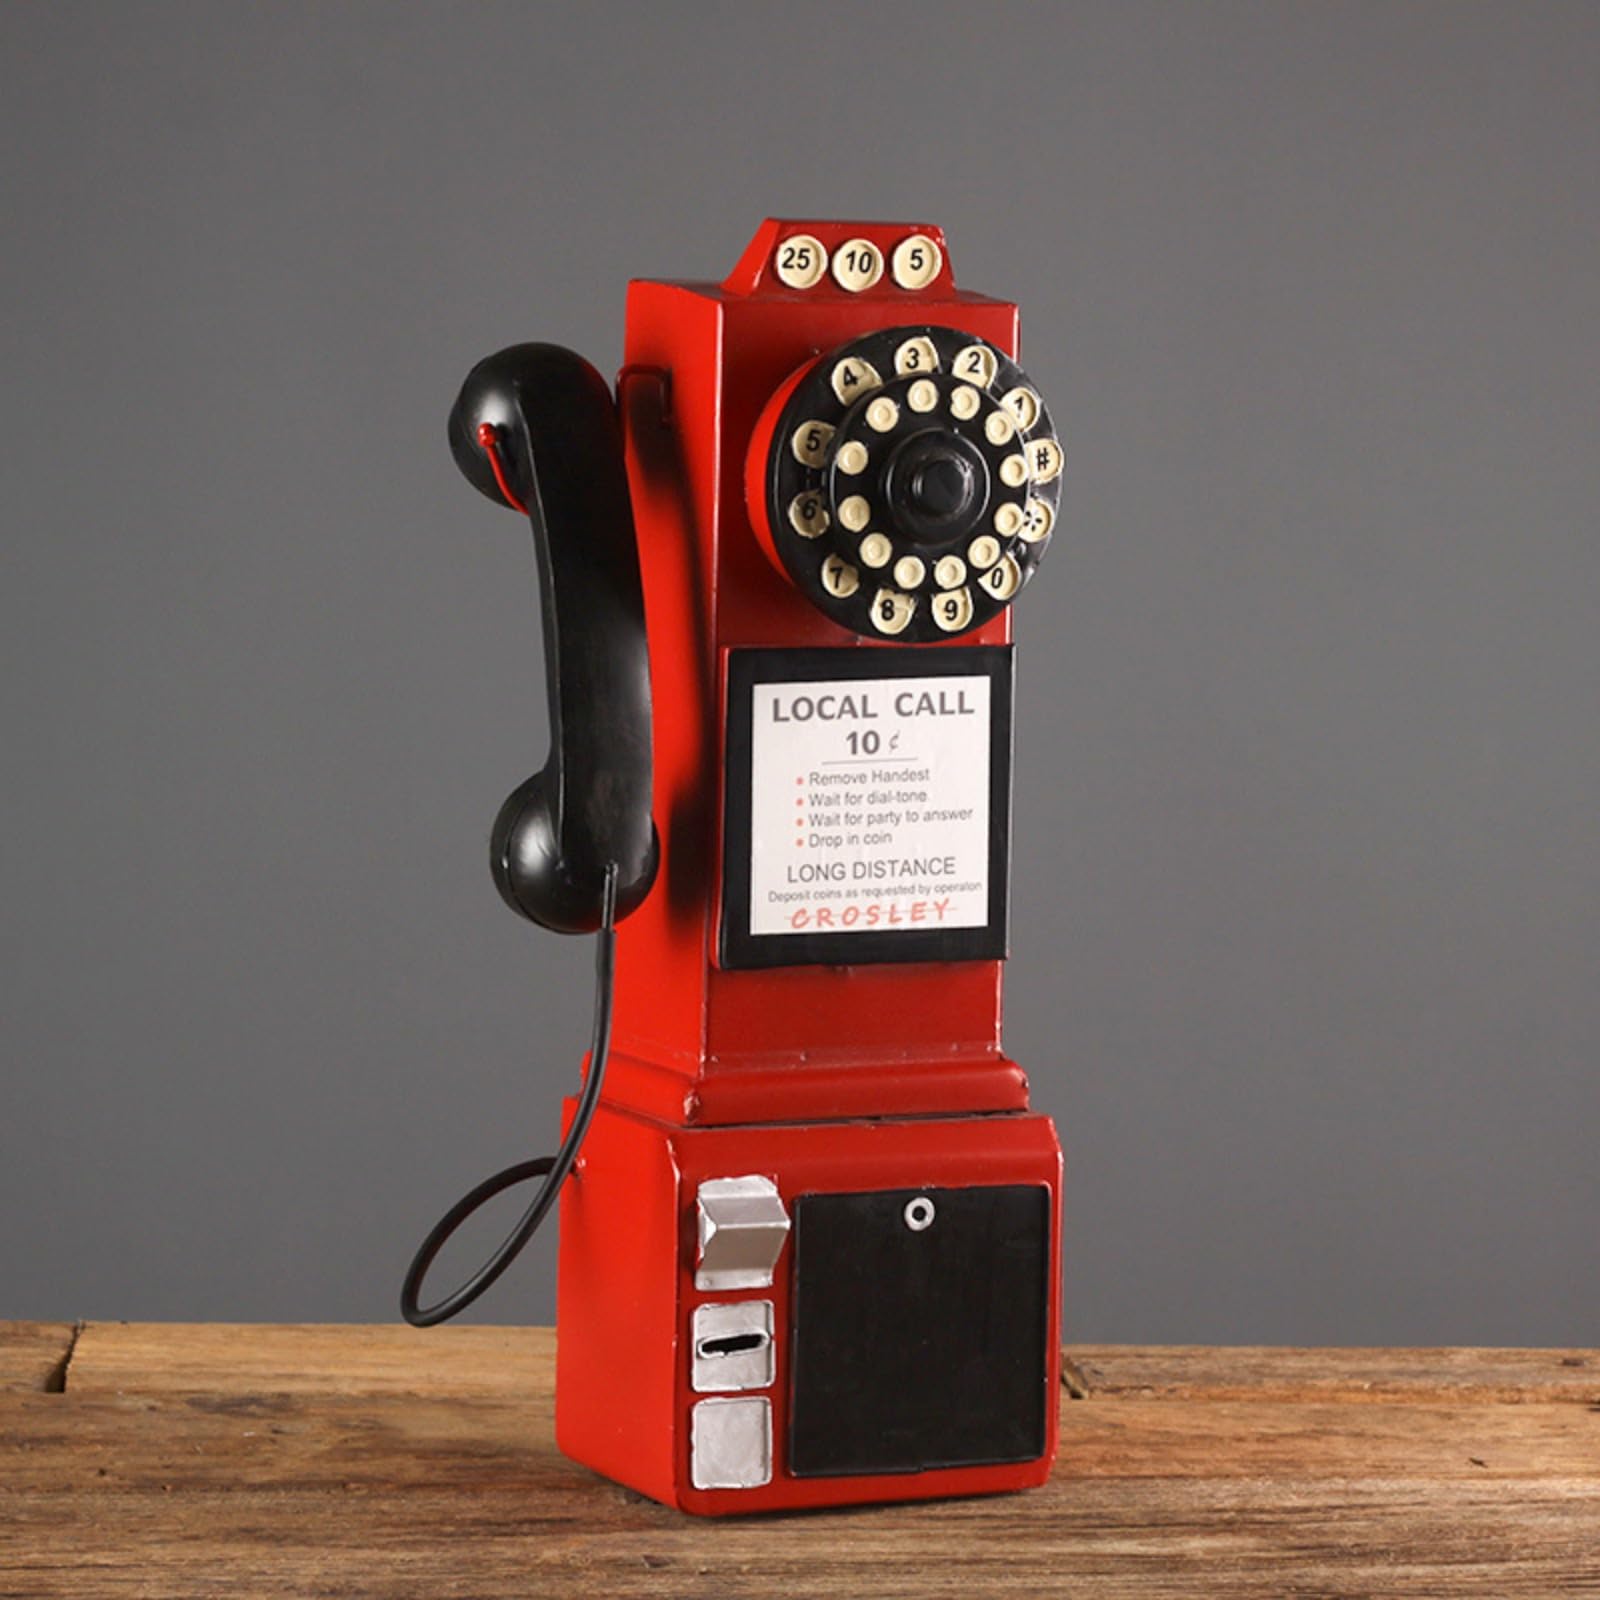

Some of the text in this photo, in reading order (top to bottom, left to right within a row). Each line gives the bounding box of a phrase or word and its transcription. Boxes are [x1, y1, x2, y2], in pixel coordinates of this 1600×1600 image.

[782, 248, 811, 270] 25
[846, 250, 872, 273] 10
[910, 248, 924, 270] 5
[906, 347, 919, 369] 3
[968, 351, 981, 373] 2
[843, 366, 858, 386] 4
[805, 430, 820, 452] 5
[803, 498, 819, 519] 6
[829, 567, 844, 590] 7
[991, 567, 1004, 589] 0
[881, 598, 895, 621] 8
[944, 599, 958, 621] 9
[772, 690, 975, 723] LOCAL CALL
[846, 730, 880, 755] 10
[808, 767, 930, 787] Remove Handest
[807, 789, 928, 807] Wait for dial-tone
[807, 808, 973, 828] Wait for party to answer
[808, 829, 893, 849] Drop in coin
[787, 856, 956, 884] LONG DISTANCE
[768, 888, 811, 904] Deposit
[813, 886, 842, 900] coins
[845, 886, 859, 899] as
[861, 883, 916, 901] requested
[918, 882, 932, 897] by
[790, 897, 950, 929] CROSLEY
